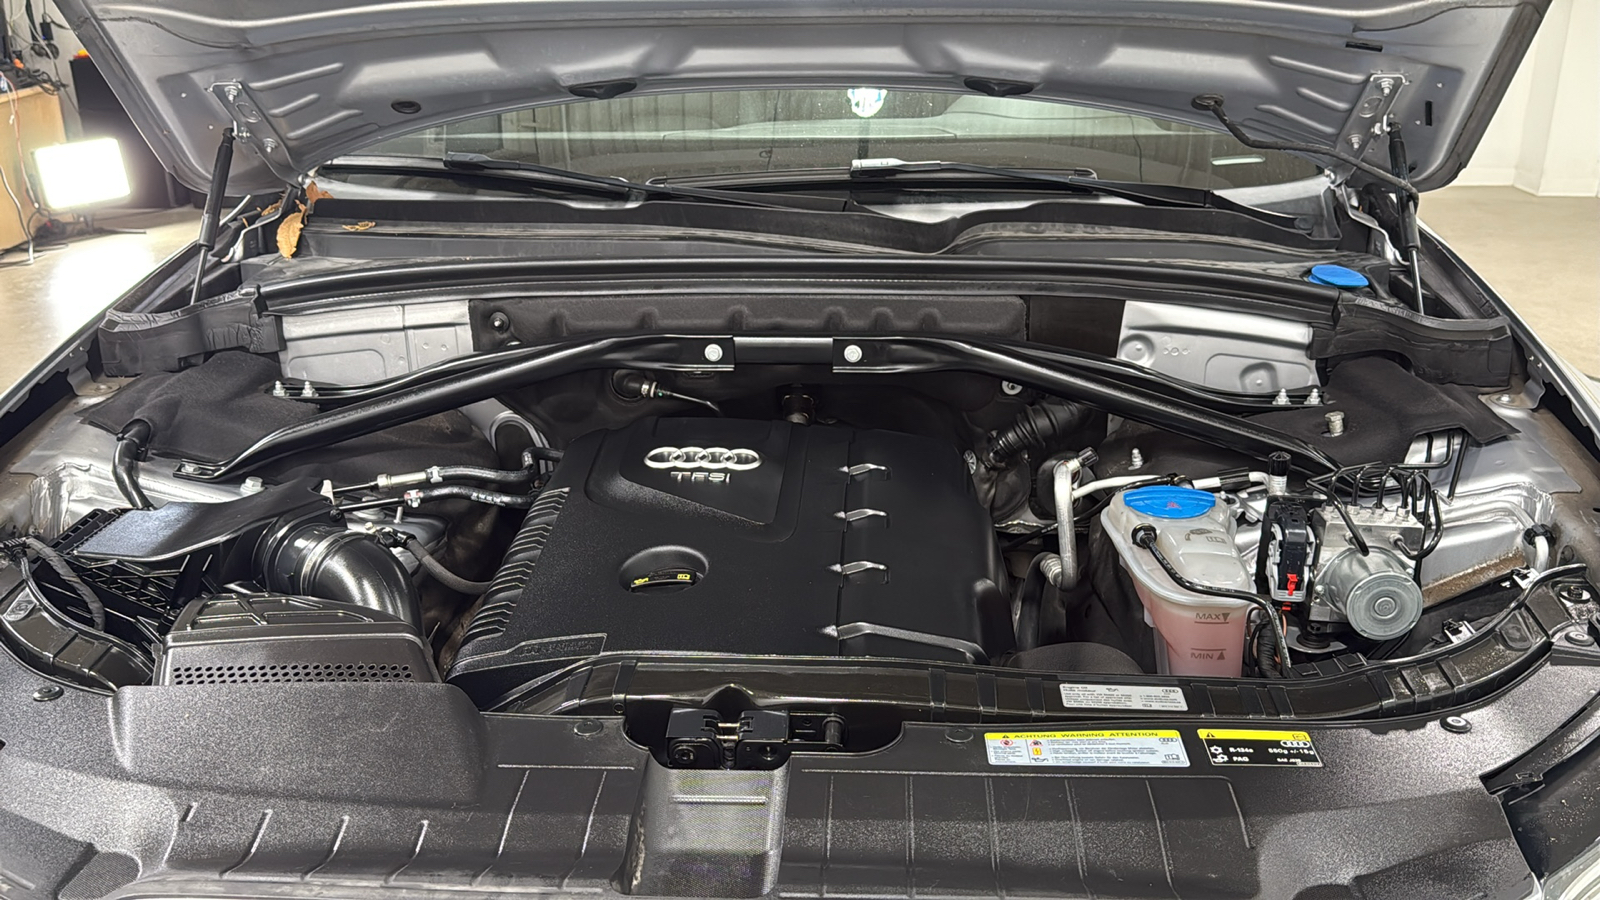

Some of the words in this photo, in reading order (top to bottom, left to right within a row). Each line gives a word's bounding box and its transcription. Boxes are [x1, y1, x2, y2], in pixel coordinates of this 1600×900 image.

[670, 471, 731, 482] TFSI
[1195, 612, 1221, 620] MAX
[1190, 652, 1214, 660] MIN
